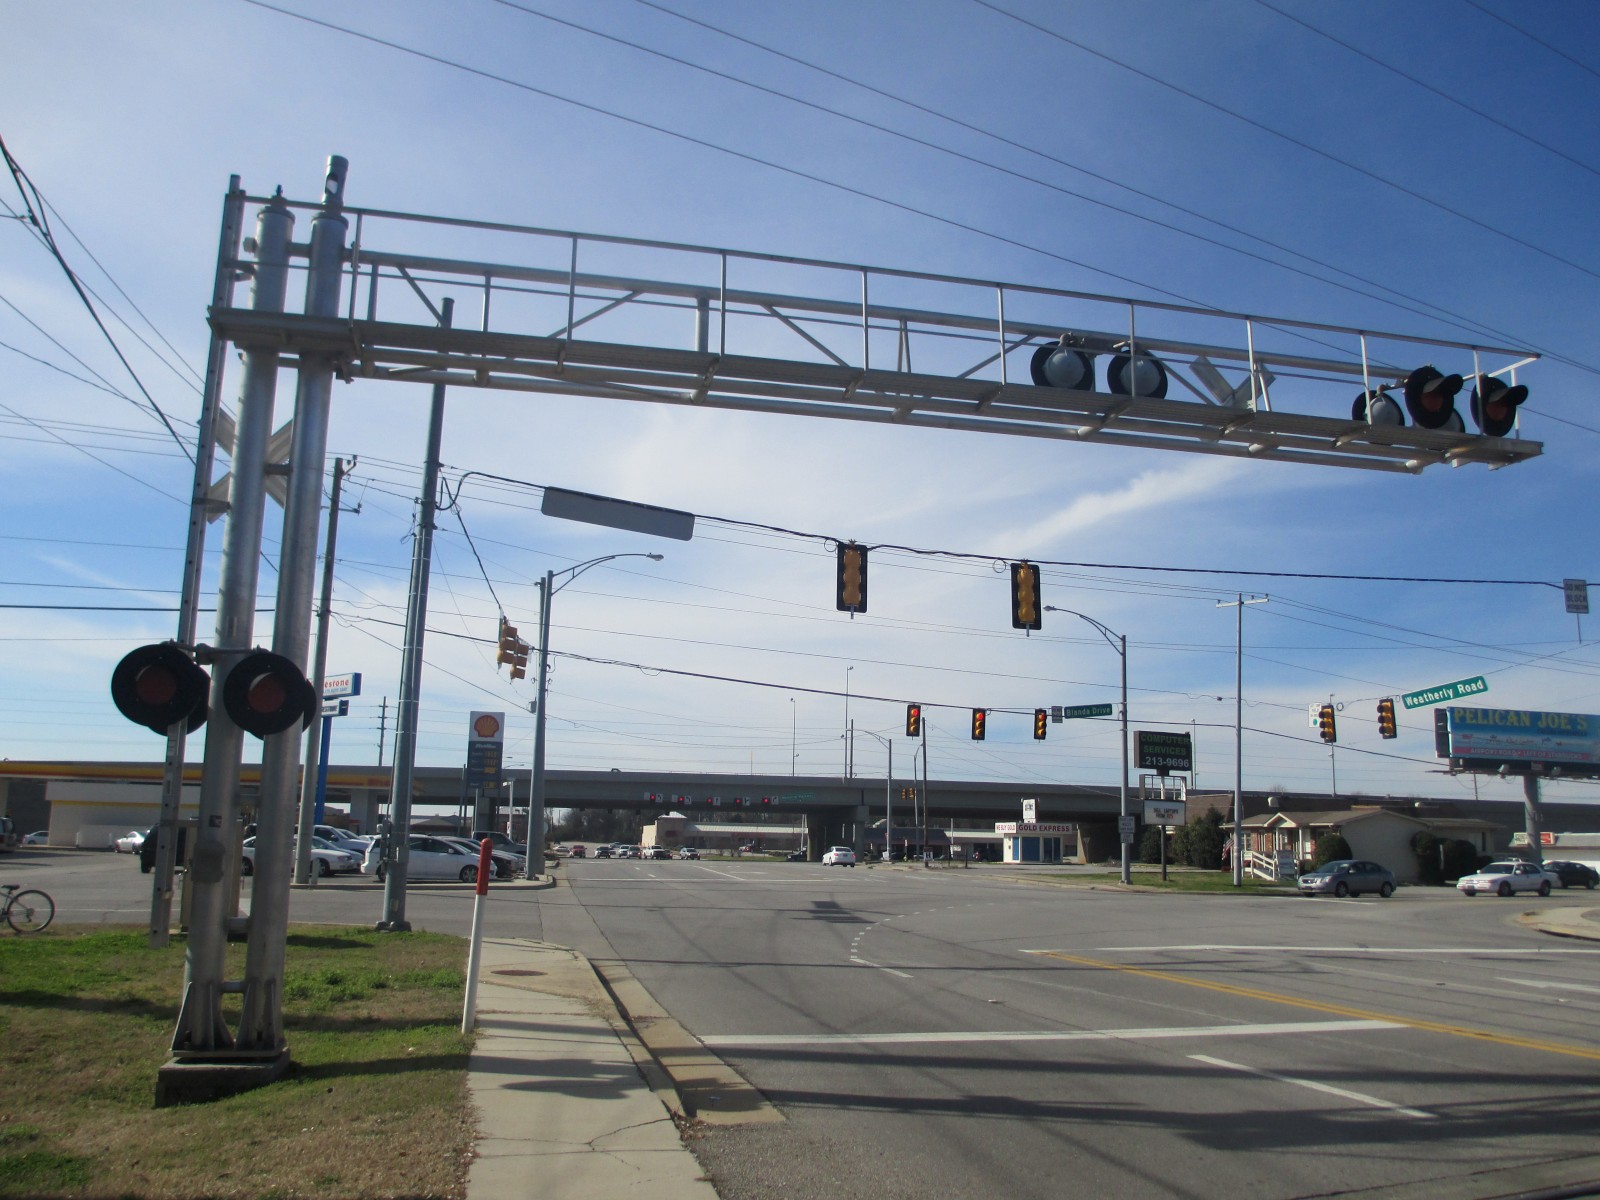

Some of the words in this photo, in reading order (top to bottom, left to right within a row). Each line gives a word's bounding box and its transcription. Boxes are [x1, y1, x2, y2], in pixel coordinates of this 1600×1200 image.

[324, 679, 349, 688] estone
[1405, 688, 1454, 706] Weatherly
[1457, 680, 1484, 694] Road
[1066, 708, 1090, 716] Blanda
[1092, 706, 1111, 714] Drive
[1454, 707, 1531, 727] PELICAN
[1538, 712, 1588, 731] JOE'S
[1141, 734, 1189, 745] COMPUTER
[1143, 745, 1186, 755] SERVICES
[1145, 756, 1190, 768] 213-9696
